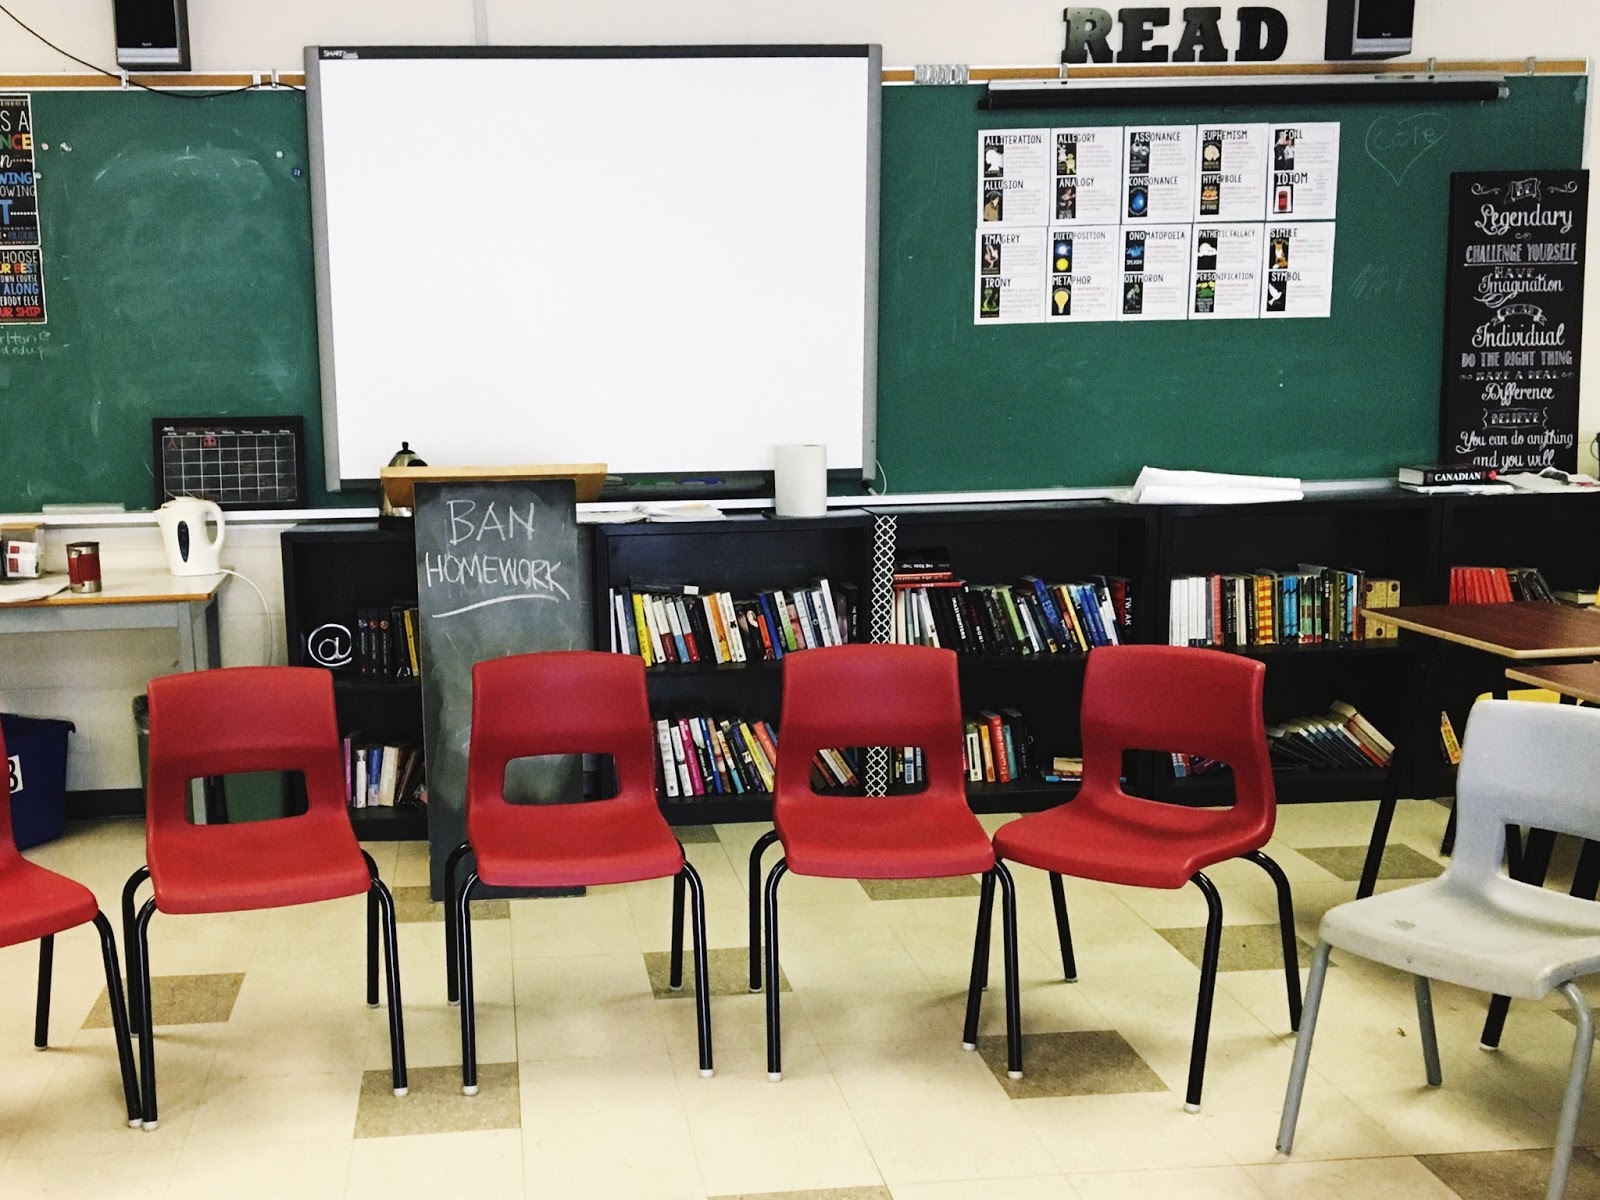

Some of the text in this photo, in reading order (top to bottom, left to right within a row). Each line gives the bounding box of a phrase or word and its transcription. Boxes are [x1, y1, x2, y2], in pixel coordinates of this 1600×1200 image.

[1061, 7, 1288, 64] READ
[18, 110, 30, 132] A
[985, 134, 1042, 146] ALLITERATION
[1058, 133, 1095, 143] ALLEGORY
[1134, 132, 1180, 142] ASSONANCE
[1203, 130, 1247, 141] EUPHEMISM
[1284, 129, 1303, 140] FOIL
[1059, 177, 1094, 188] ANALOGY
[1129, 176, 1178, 186] CONSONANCE
[1203, 174, 1242, 184] HYPERBOLE
[1276, 173, 1308, 185] IDIOM
[985, 180, 1023, 191] ALLUSION
[1475, 203, 1573, 235] Legendary
[1053, 232, 1106, 241] JUXTAPOSITION
[1129, 231, 1185, 241] ONOMATOPOEIA
[1198, 230, 1255, 239] PATHETIC FALLACY
[1270, 228, 1297, 238] SIMILE
[985, 234, 1020, 245] IMAGERY
[0, 250, 38, 263] HOOSE
[1465, 243, 1577, 263] CHALLENGE YOURSELF
[14, 263, 37, 274] BEST
[1494, 267, 1535, 279] HAVE
[16, 274, 37, 282] COURSE
[1052, 276, 1091, 286] METAPHOR
[1124, 273, 1163, 283] OXYMORON
[1196, 272, 1254, 281] PERSONIFICATION
[1271, 272, 1302, 282] SYMBOL
[985, 278, 1012, 288] IRONY
[1476, 273, 1564, 300] Imagination
[3, 283, 39, 295] ALONG
[23, 296, 39, 306] ELSE
[16, 307, 41, 317] SHIP
[1472, 322, 1565, 348] Individual
[1461, 350, 1573, 368] DO THE RIGHT THING
[1475, 370, 1559, 381] MAKE A REAL
[1481, 382, 1555, 406] Difference
[1491, 412, 1541, 424] BELIEVE
[1455, 429, 1574, 453] You can do anything
[1472, 449, 1555, 473] and you will
[1434, 472, 1482, 482] CANADIAN
[446, 499, 535, 546] BAN
[425, 551, 571, 601] HOMEWORK
[1123, 596, 1133, 626] TWEAK
[955, 613, 967, 640] HUNTERS
